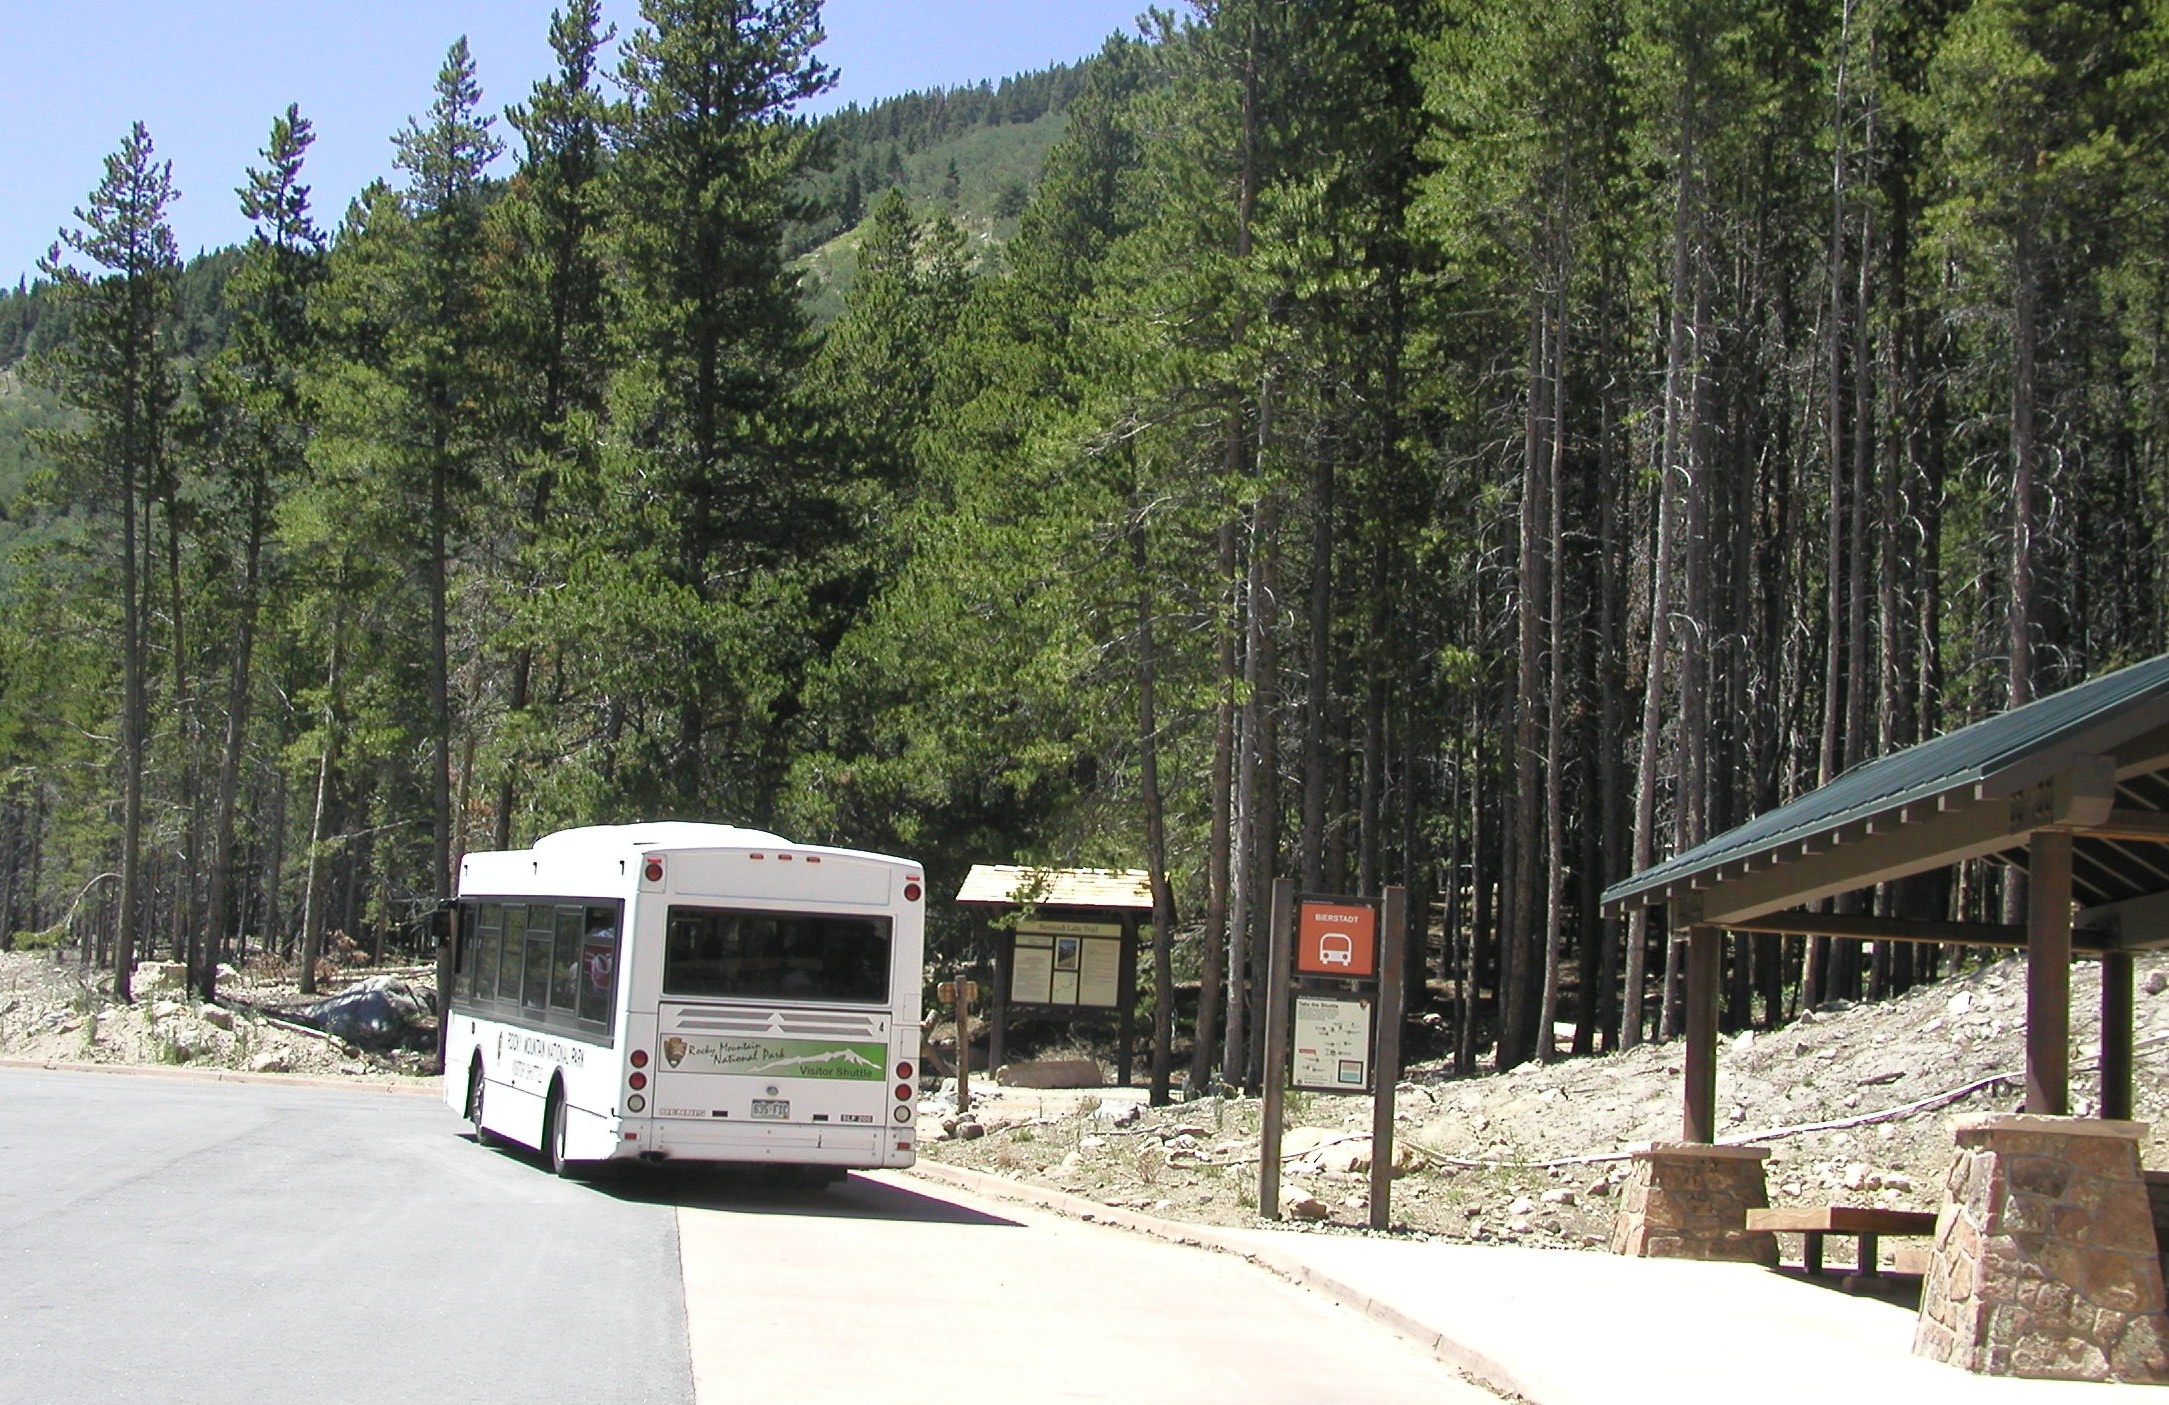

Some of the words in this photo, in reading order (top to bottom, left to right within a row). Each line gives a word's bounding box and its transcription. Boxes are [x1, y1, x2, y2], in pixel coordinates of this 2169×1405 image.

[1315, 914, 1359, 923] BIERSTADT
[1067, 924, 1083, 932] Lake
[1084, 925, 1099, 933] Trail
[879, 1021, 885, 1033] 4
[688, 1044, 716, 1057] Rocky
[719, 1042, 762, 1052] Mountain
[713, 1051, 758, 1065] National
[763, 1048, 786, 1060] Park
[800, 1066, 833, 1077] Visitor
[836, 1066, 873, 1078] Shuttle
